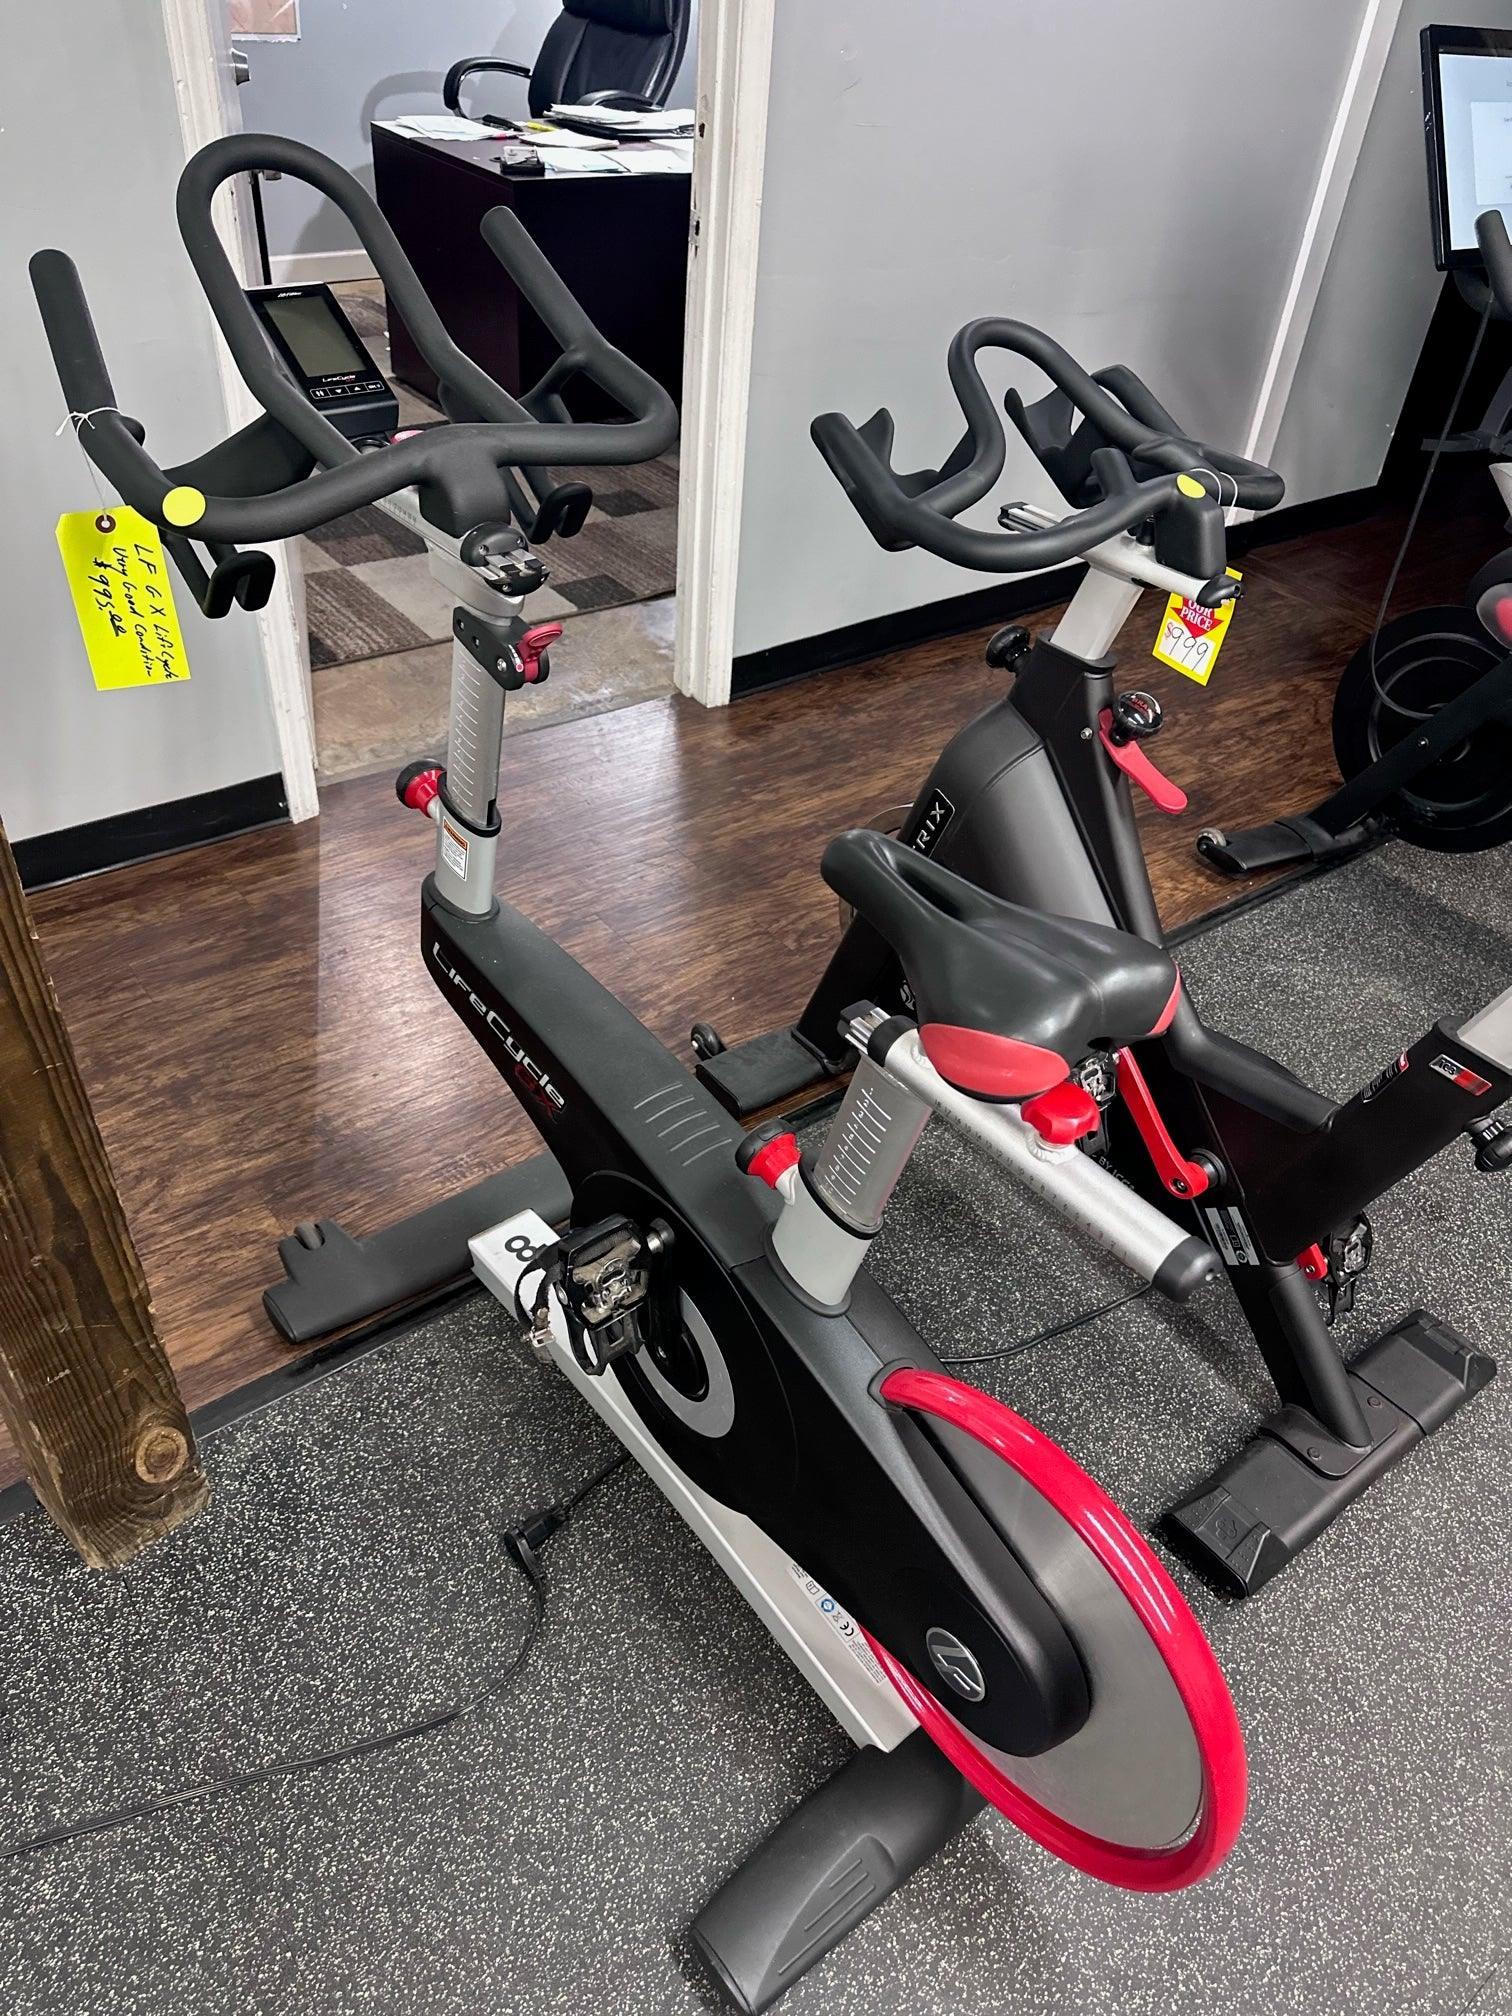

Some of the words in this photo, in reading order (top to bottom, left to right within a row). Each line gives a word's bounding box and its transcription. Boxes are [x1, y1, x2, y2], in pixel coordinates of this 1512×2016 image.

[123, 581, 145, 618] Good
[1180, 605, 1213, 631] PRICE
[1165, 621, 1209, 671] $999
[914, 801, 945, 849] RIX
[1099, 1156, 1113, 1170] BY
[504, 1235, 539, 1262] 8
